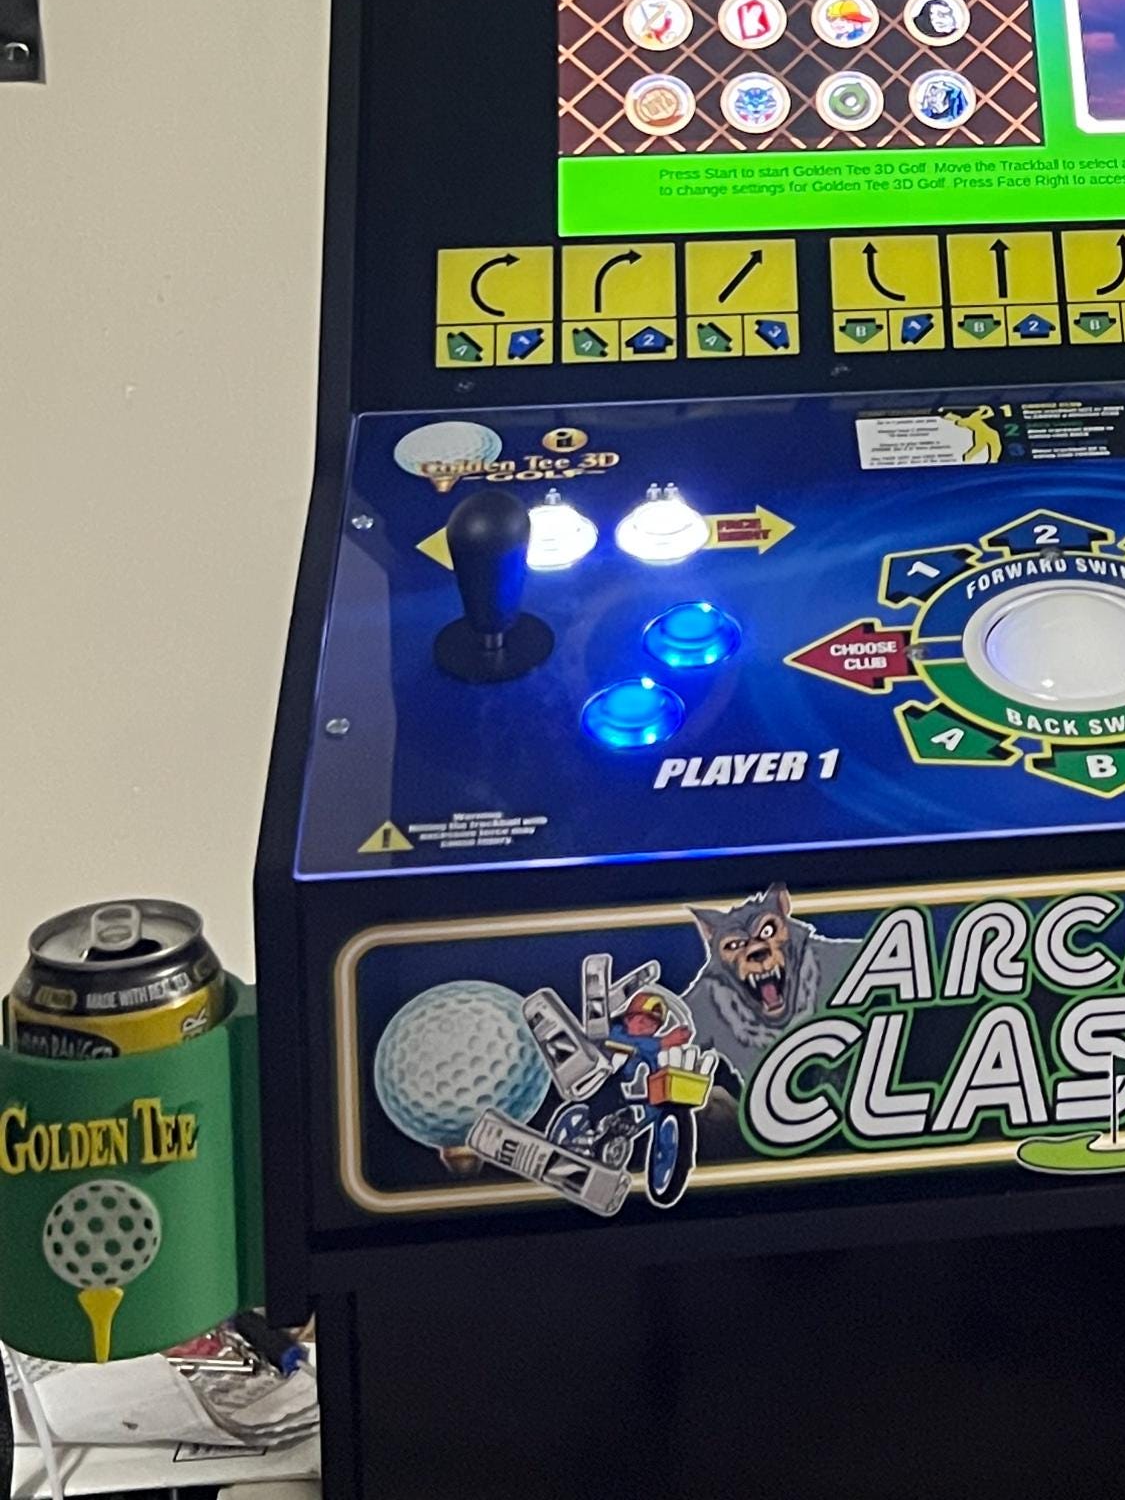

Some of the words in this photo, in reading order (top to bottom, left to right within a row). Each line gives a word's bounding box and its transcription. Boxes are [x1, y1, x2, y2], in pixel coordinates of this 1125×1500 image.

[659, 169, 700, 180] Press
[705, 167, 737, 179] Start
[741, 167, 754, 178] to
[793, 165, 841, 177] Golden
[846, 164, 871, 176] Tee
[875, 163, 895, 175] 3D
[935, 162, 971, 173] Move
[975, 160, 996, 172] the
[1000, 159, 1059, 172] Trackball
[1063, 159, 1076, 170] to
[660, 184, 673, 196] to
[676, 184, 727, 198] change
[789, 181, 808, 192] for
[812, 180, 860, 192] Golden
[865, 179, 890, 190] Tee
[894, 178, 913, 189] 3D
[953, 176, 993, 188] Press
[997, 175, 1031, 187] Face
[1035, 174, 1069, 189] Right
[1073, 174, 1086, 185] to
[525, 455, 571, 472] Tee
[582, 452, 620, 469] 3D
[1033, 525, 1060, 543] 2
[906, 559, 941, 581] 1
[966, 556, 1068, 599] FORWARD
[830, 640, 897, 659] CHOOSE
[843, 655, 887, 671] CLUB
[1006, 706, 1079, 736] BACK
[930, 726, 964, 750] A
[653, 751, 807, 789] PLAYER
[817, 749, 840, 779] 1
[1086, 754, 1118, 779] B
